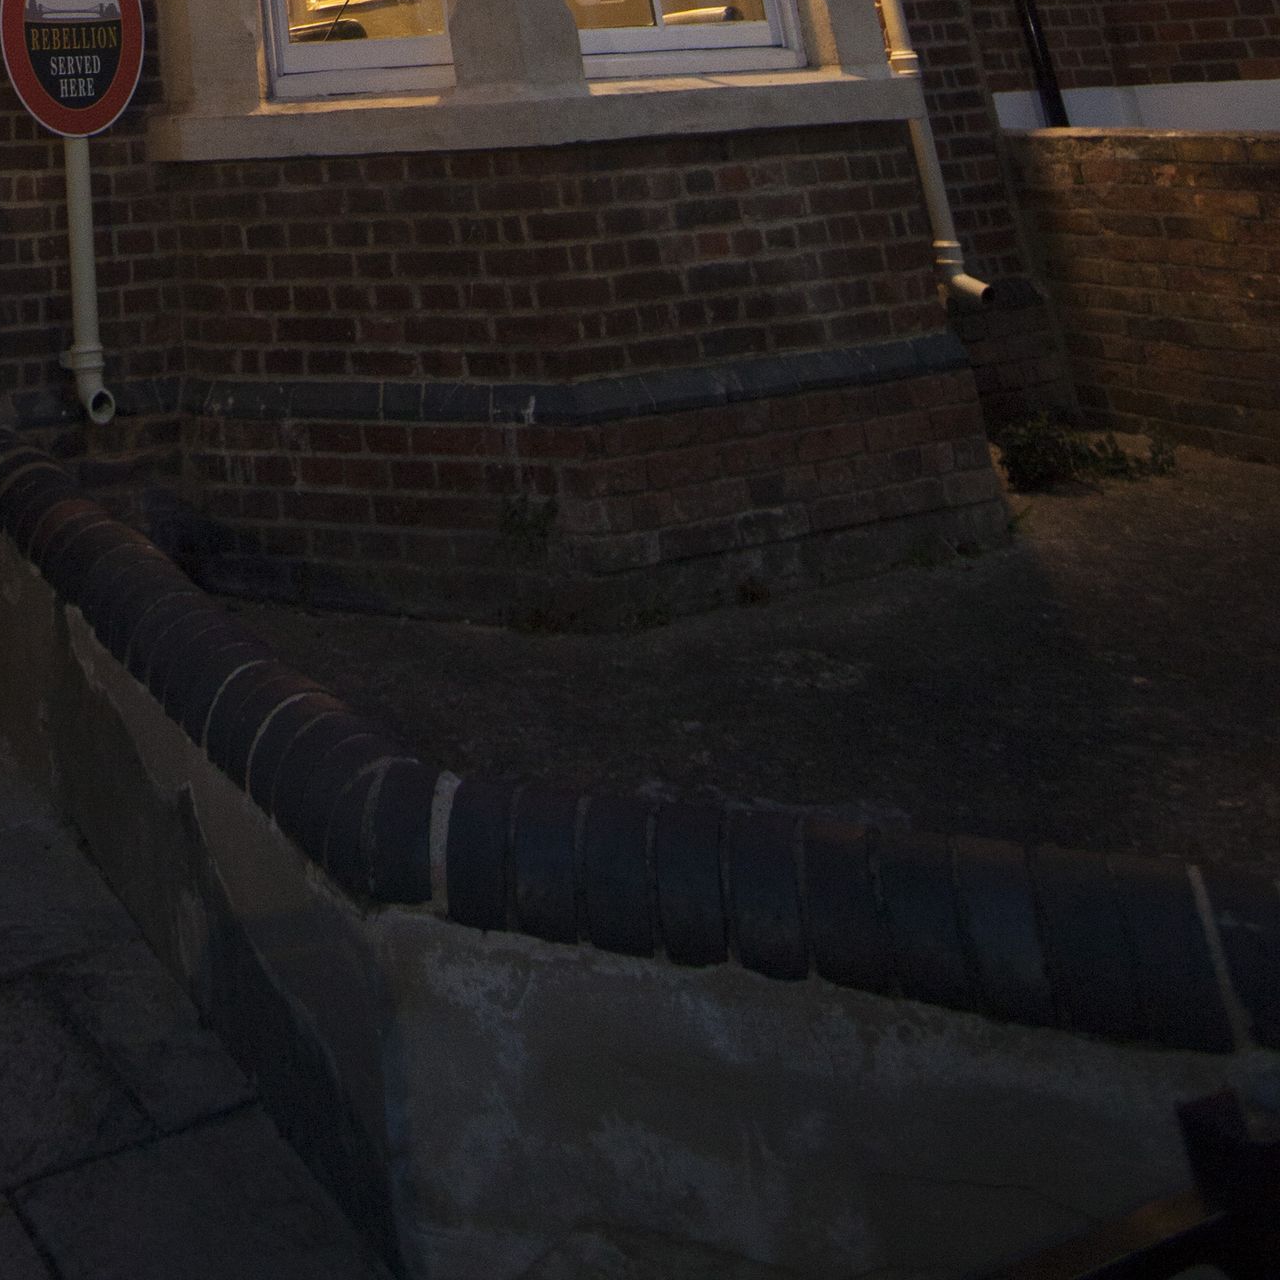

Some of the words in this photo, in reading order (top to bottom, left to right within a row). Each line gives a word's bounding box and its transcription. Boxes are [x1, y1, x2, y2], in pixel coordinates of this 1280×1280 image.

[30, 26, 118, 51] REBELLION
[50, 55, 102, 76] SERVED
[59, 77, 95, 98] HERE
